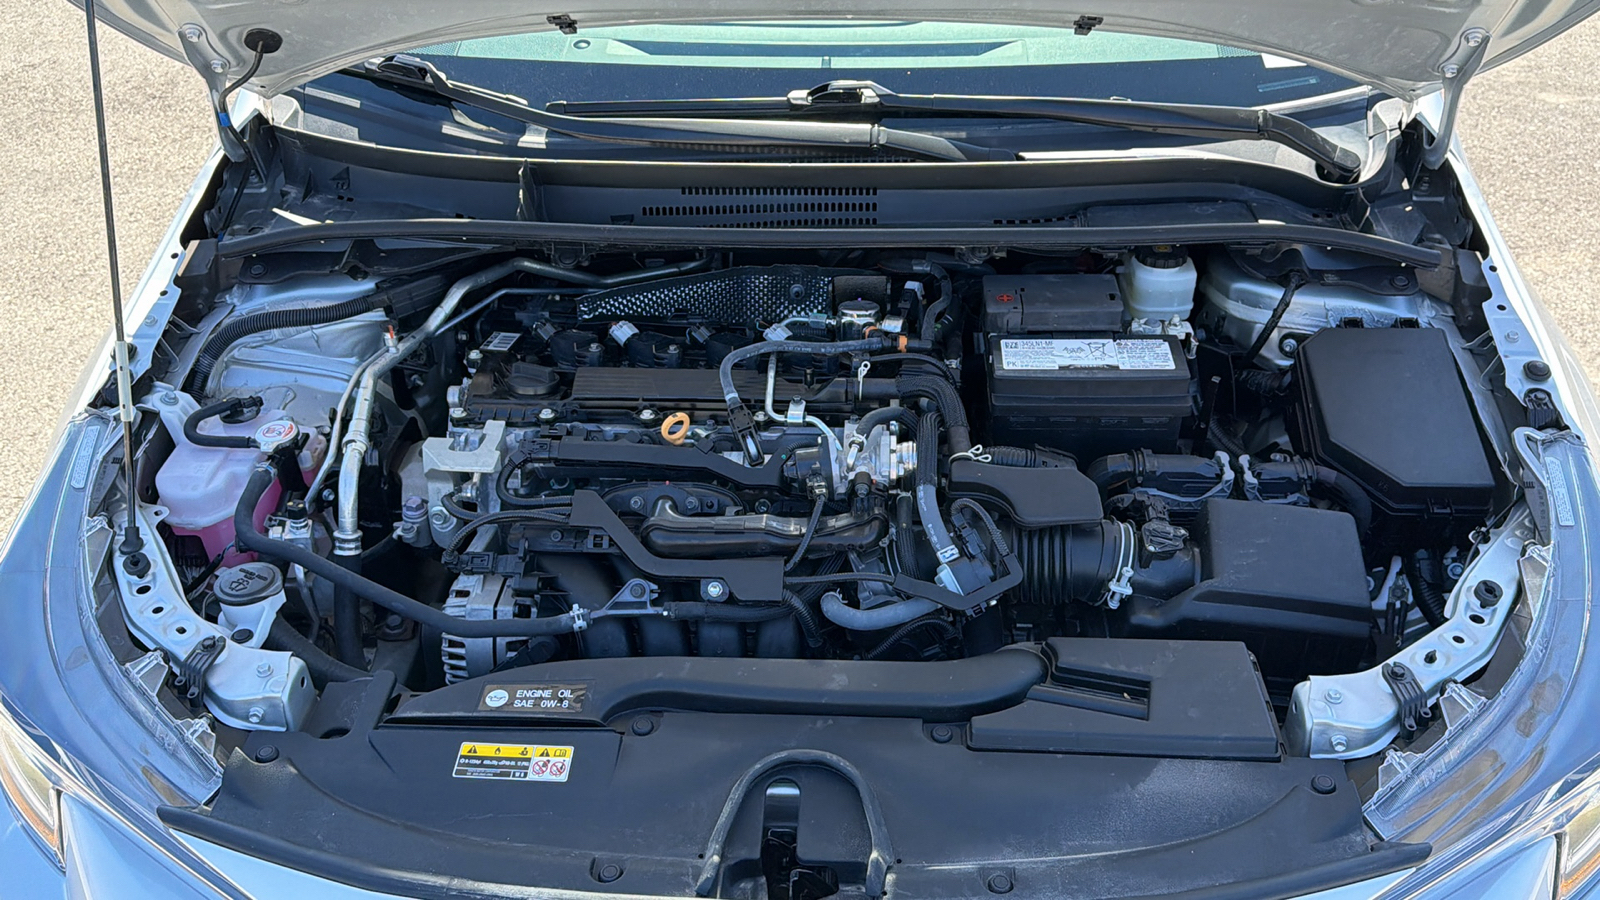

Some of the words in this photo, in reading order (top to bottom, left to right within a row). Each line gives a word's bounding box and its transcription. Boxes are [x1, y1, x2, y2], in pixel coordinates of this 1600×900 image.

[516, 689, 553, 698] ENGINE
[558, 689, 574, 698] OIL
[513, 699, 535, 708] SAE
[540, 699, 569, 708] 0W-8
